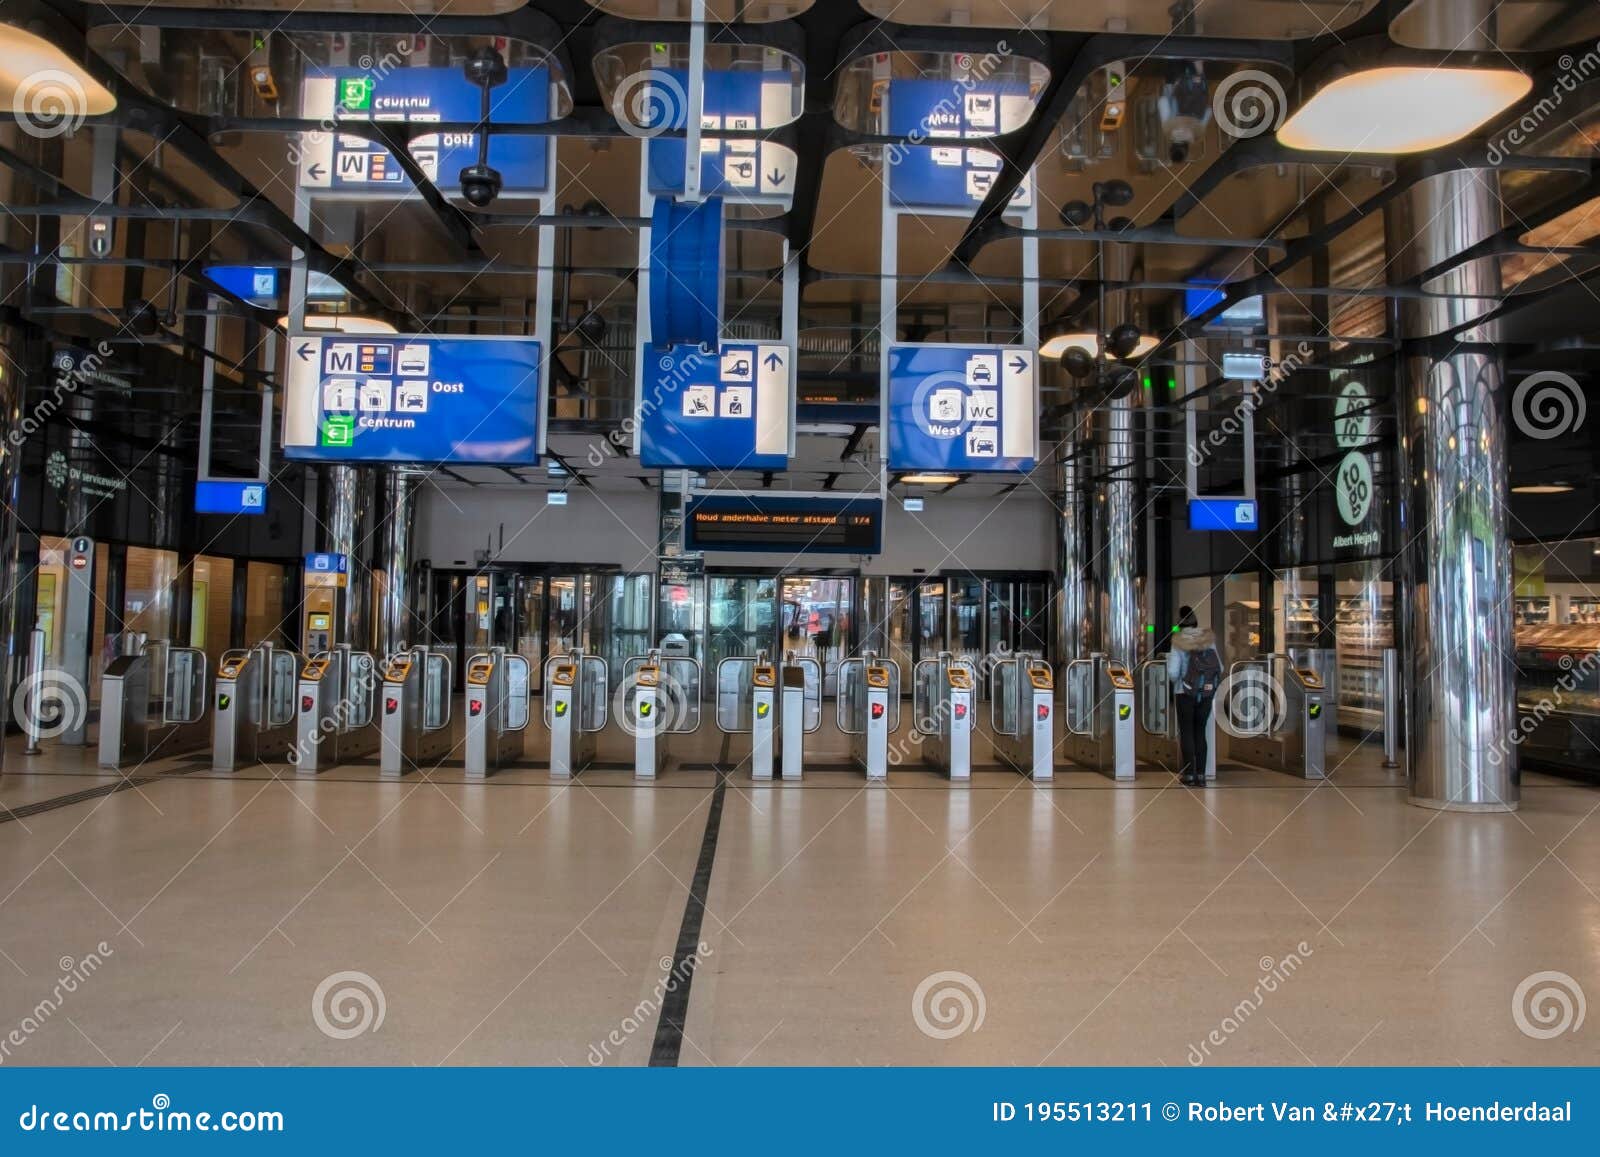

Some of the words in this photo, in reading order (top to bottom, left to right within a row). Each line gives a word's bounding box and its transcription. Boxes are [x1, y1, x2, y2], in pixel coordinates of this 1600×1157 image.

[331, 352, 352, 371] M
[432, 381, 464, 393] Oost
[970, 406, 994, 418] WC
[358, 416, 415, 429] Centrum
[928, 424, 962, 436] West
[696, 513, 718, 522] Houd
[722, 514, 768, 523] anderhalve
[772, 516, 799, 524] meter
[803, 516, 837, 525] afstand
[1333, 535, 1353, 548] Albert
